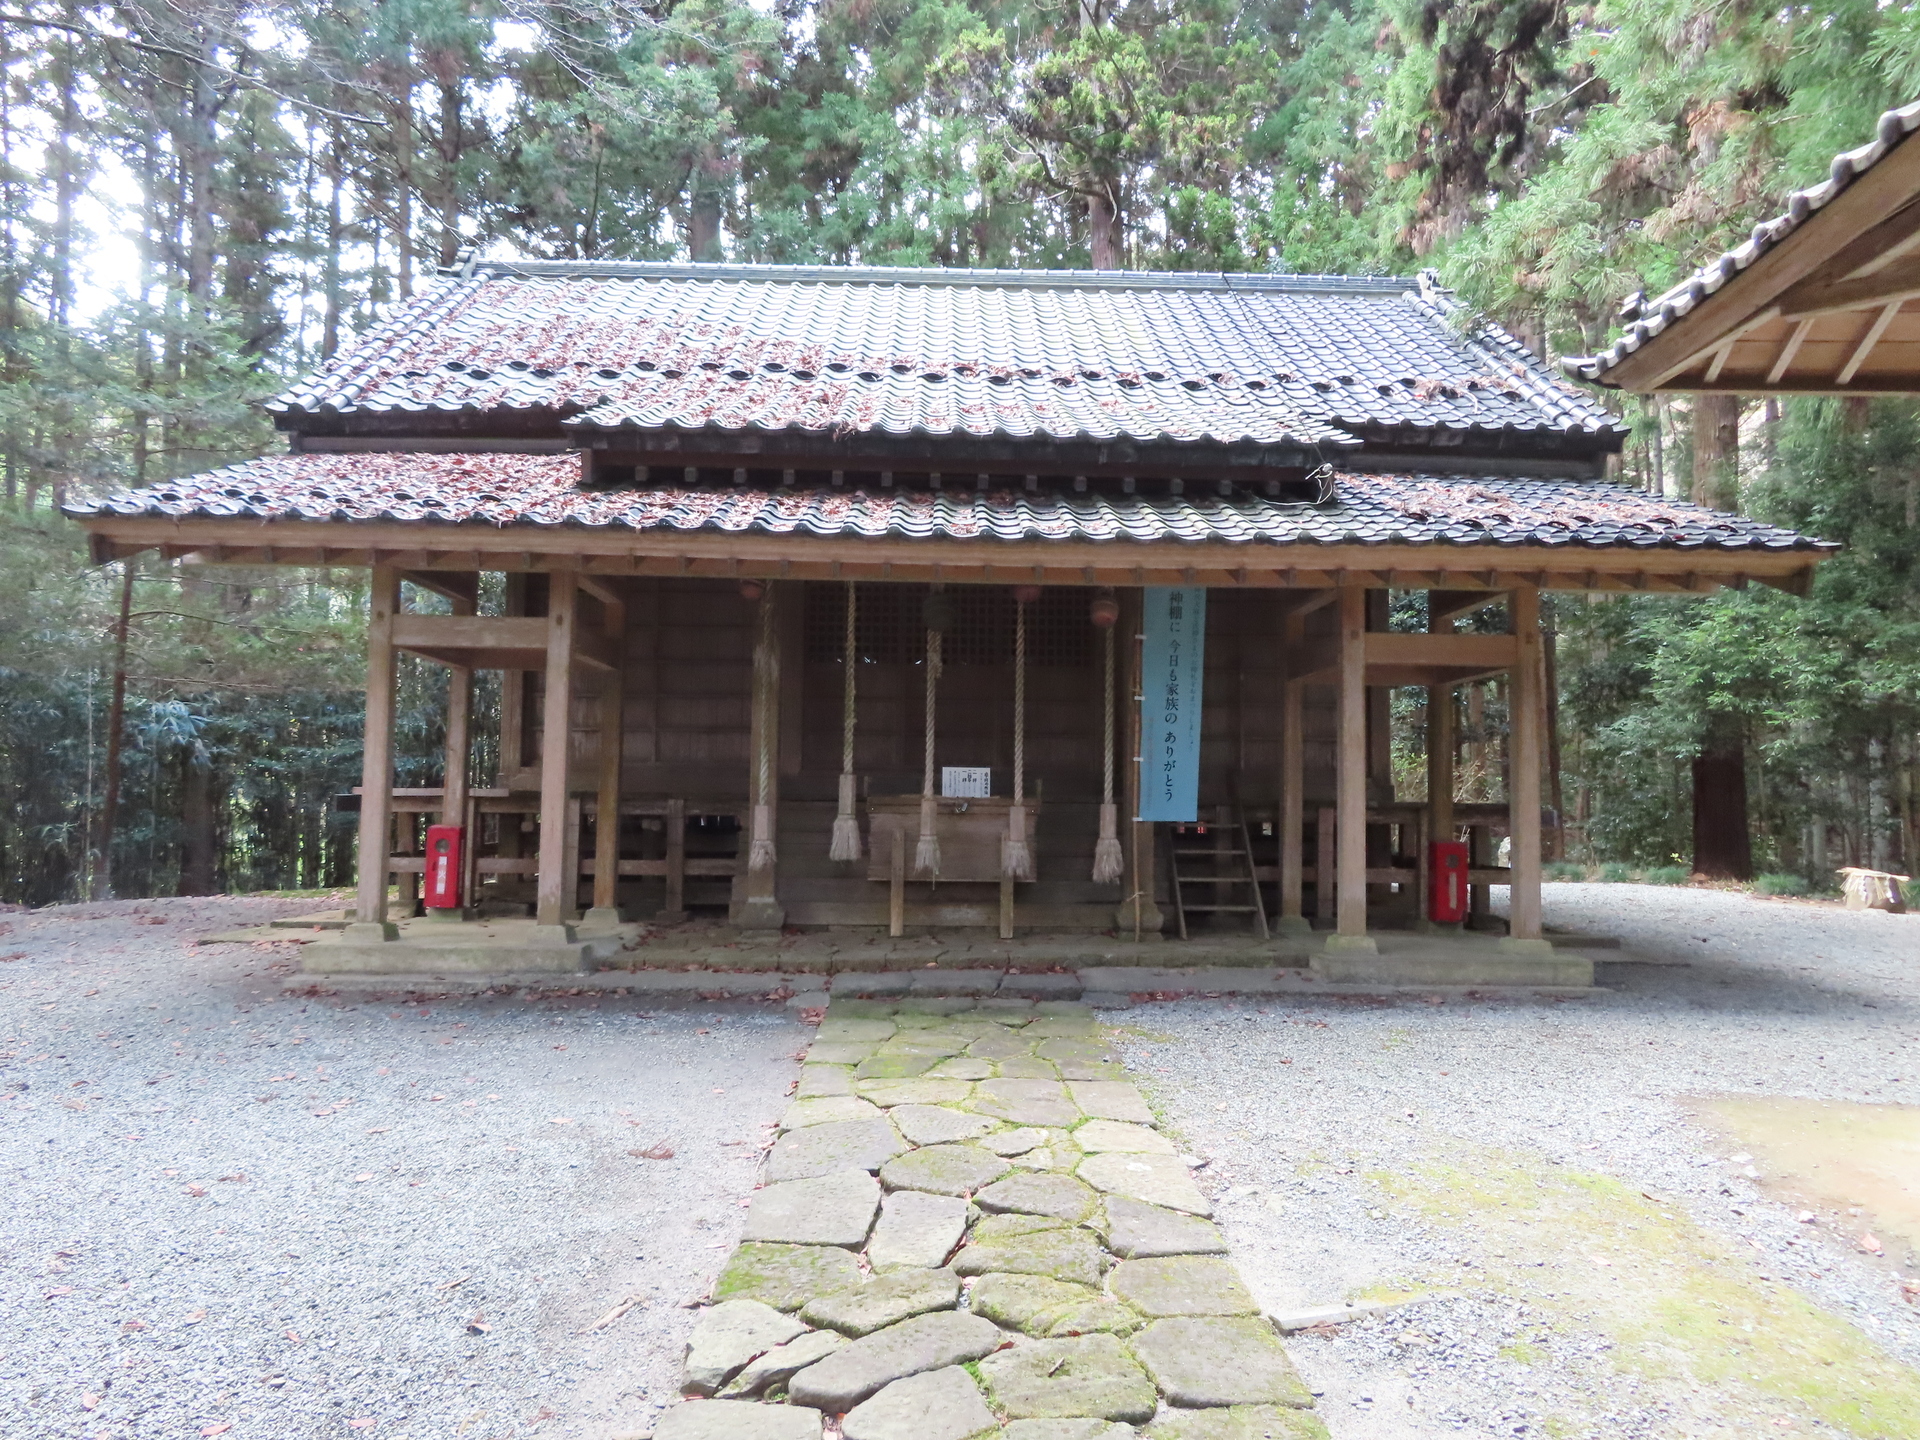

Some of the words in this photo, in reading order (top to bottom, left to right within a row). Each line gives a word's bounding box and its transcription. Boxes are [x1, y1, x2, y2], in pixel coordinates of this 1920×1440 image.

[1168, 590, 1183, 633] 神棚に
[1164, 638, 1181, 725] 今日も家族の
[1163, 730, 1177, 803] ありがとう
